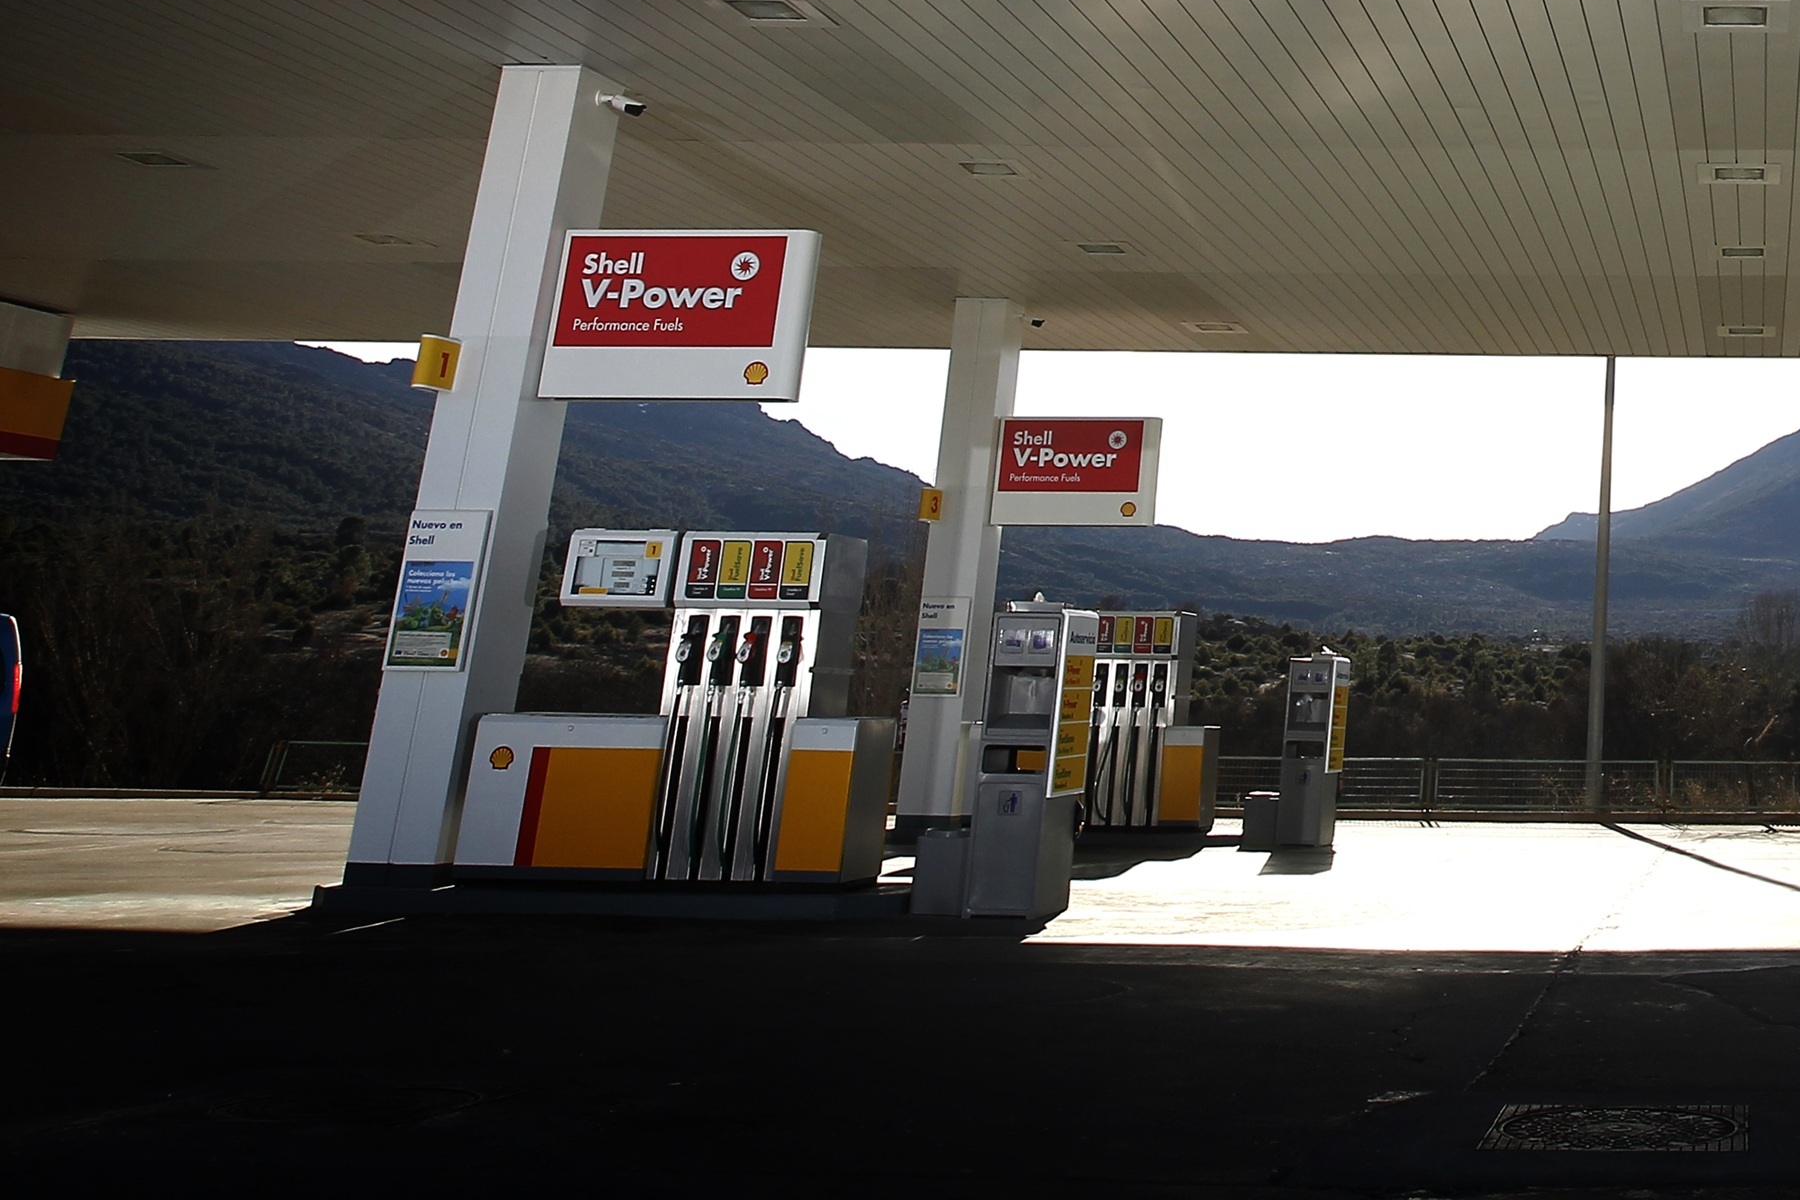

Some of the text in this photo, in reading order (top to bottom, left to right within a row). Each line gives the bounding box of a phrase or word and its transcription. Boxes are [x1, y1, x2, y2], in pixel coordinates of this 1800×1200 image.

[582, 252, 644, 274] Shell
[581, 278, 743, 309] V-Power
[572, 317, 684, 331] Performance Fuels
[440, 352, 450, 378] 1
[1013, 431, 1053, 445] Shell
[1013, 448, 1117, 467] V-Power
[1009, 473, 1080, 482] Performance Fuels
[931, 496, 939, 513] 3
[412, 520, 462, 530] Nuevo en
[409, 535, 435, 545] Shell
